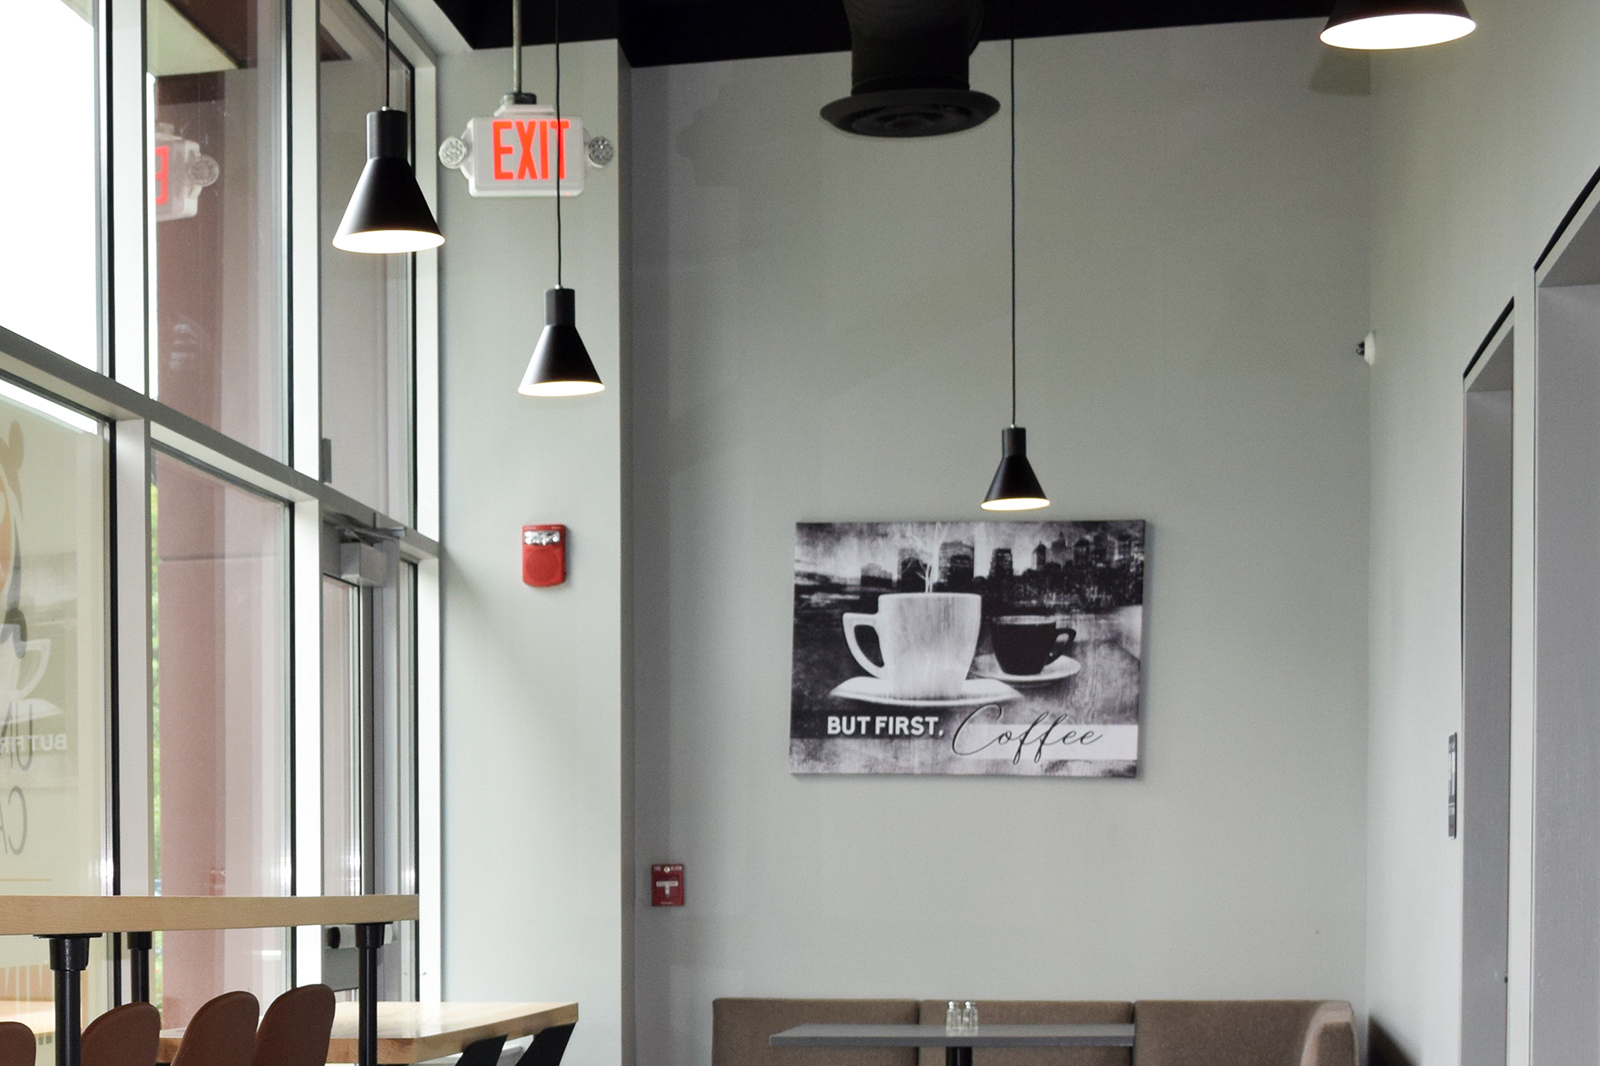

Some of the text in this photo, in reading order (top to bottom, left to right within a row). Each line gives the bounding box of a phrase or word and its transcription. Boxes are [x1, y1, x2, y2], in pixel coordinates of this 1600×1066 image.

[491, 118, 571, 181] EXIT
[826, 716, 871, 737] BUT
[951, 703, 1103, 766] Coffee
